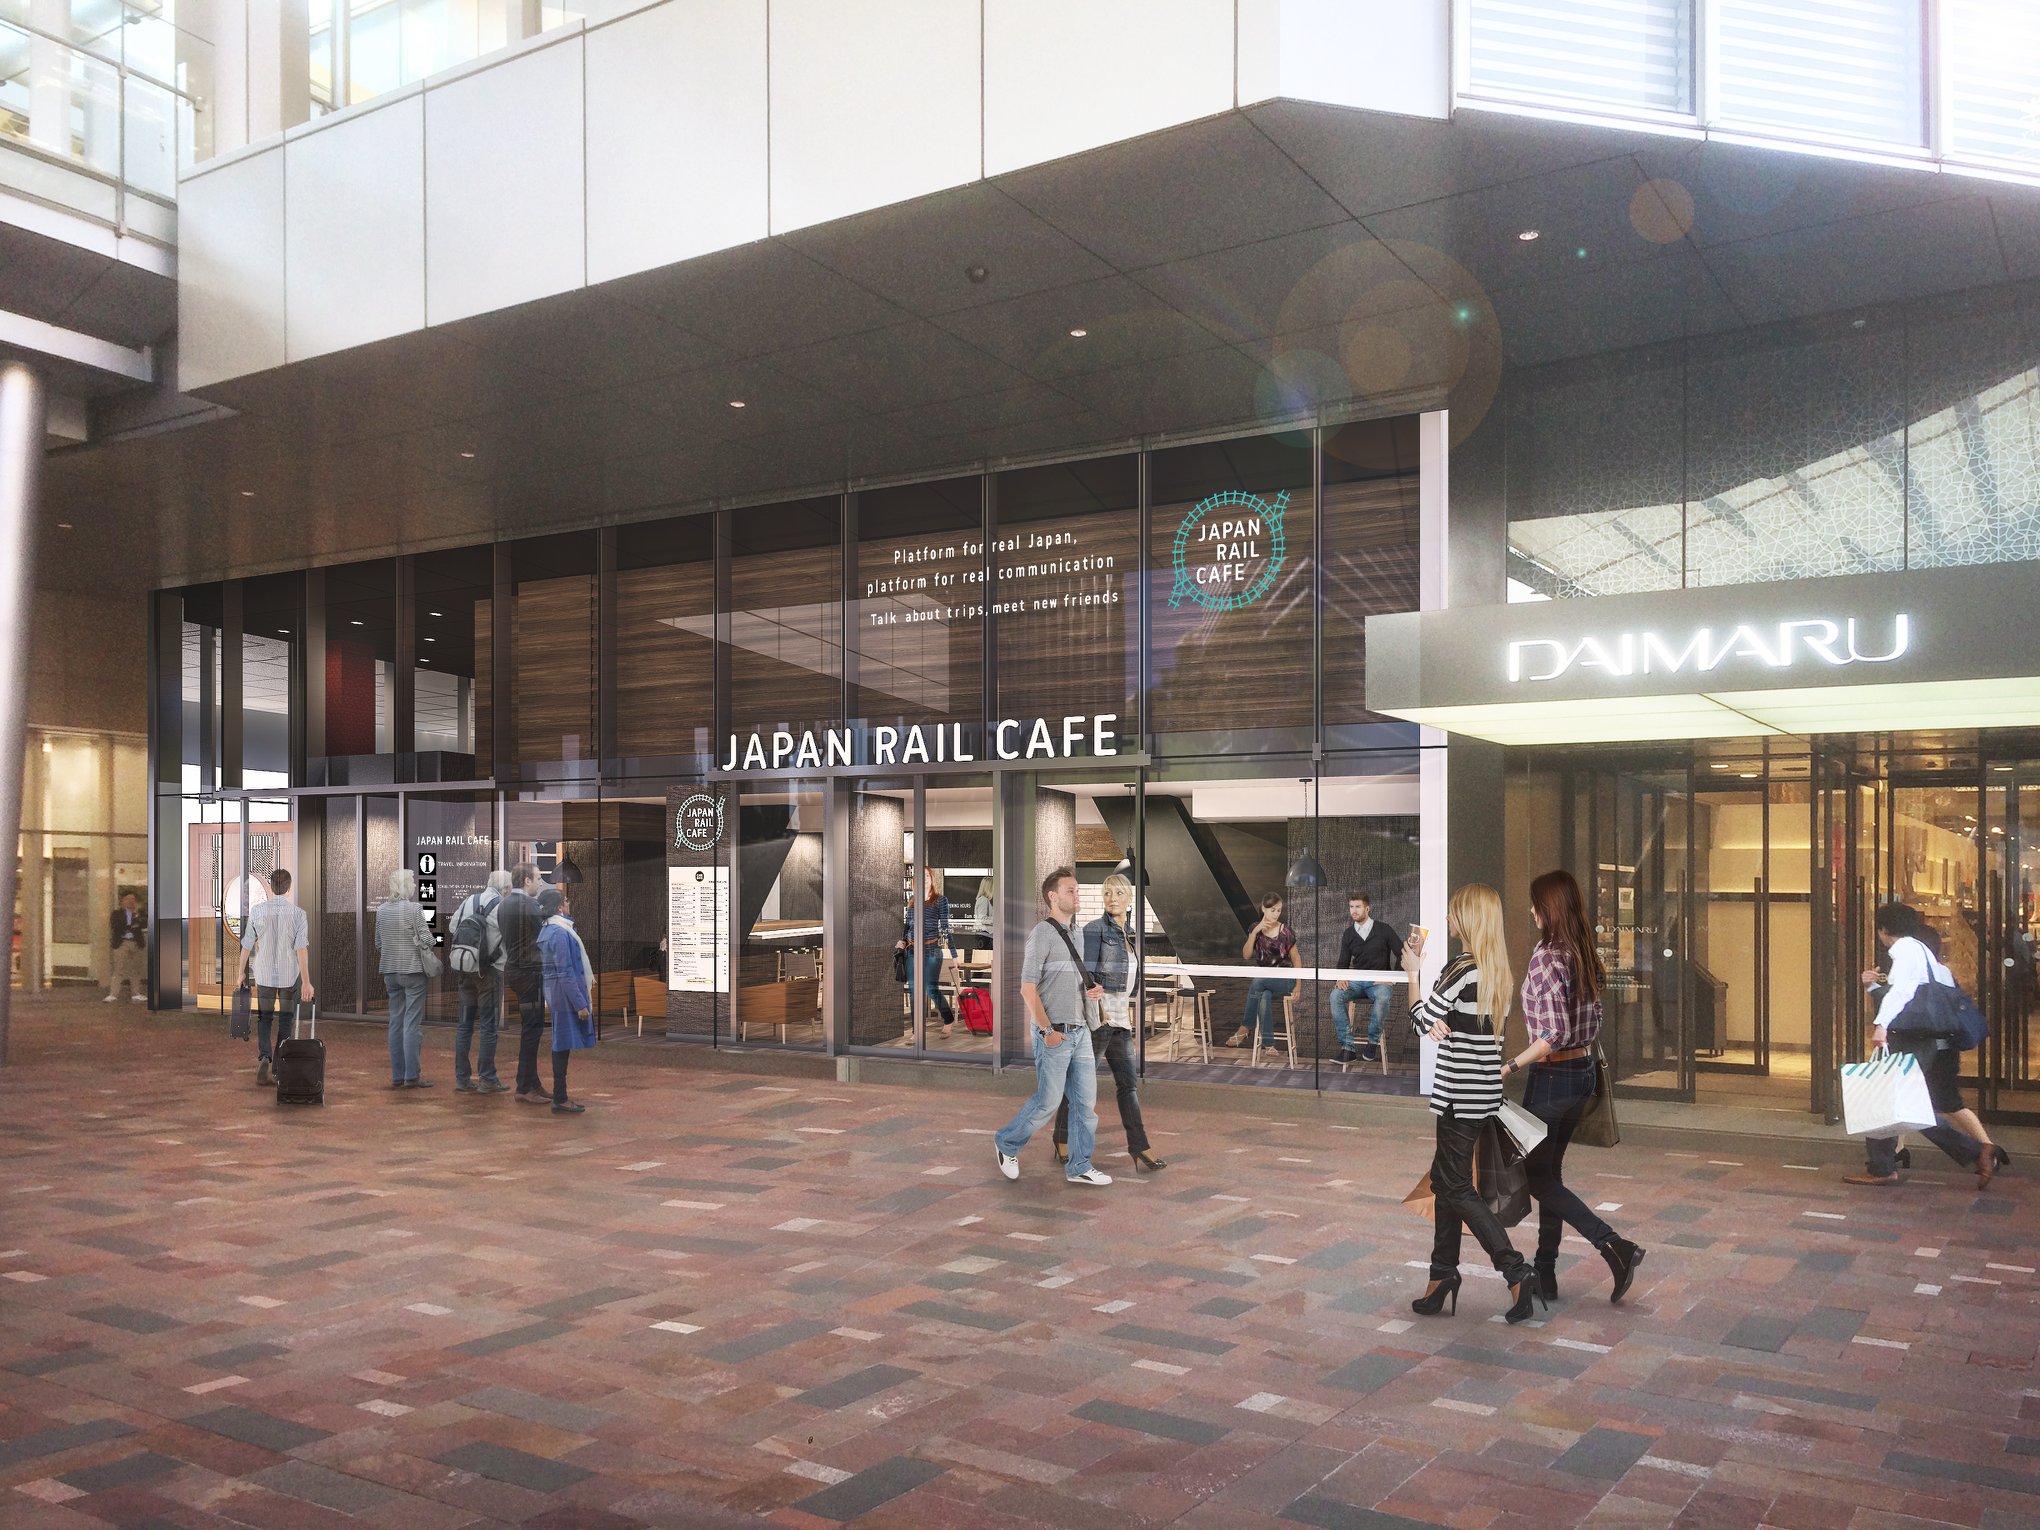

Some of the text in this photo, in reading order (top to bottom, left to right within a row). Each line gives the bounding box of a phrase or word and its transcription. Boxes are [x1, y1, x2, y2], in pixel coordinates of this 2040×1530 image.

[1198, 518, 1260, 541] JAPAN
[894, 532, 1077, 564] Platform for real Japan,
[1216, 540, 1260, 561] RAIL
[867, 554, 1114, 597] platform for real communication
[1196, 563, 1245, 584] CAFE
[870, 611, 897, 625] Talk
[905, 608, 940, 622] about
[1033, 598, 1057, 610] new
[1063, 589, 1118, 607] friends
[1508, 613, 1908, 683] DAIMARU
[722, 714, 1118, 771] JAPAN RAIL CAFE
[686, 807, 714, 817] JAPAN
[694, 818, 714, 827] RAIL
[416, 835, 489, 845] JAPAN RAIL CAFE
[686, 828, 707, 837] CAFE
[1606, 926, 1658, 934] DAIMARU
